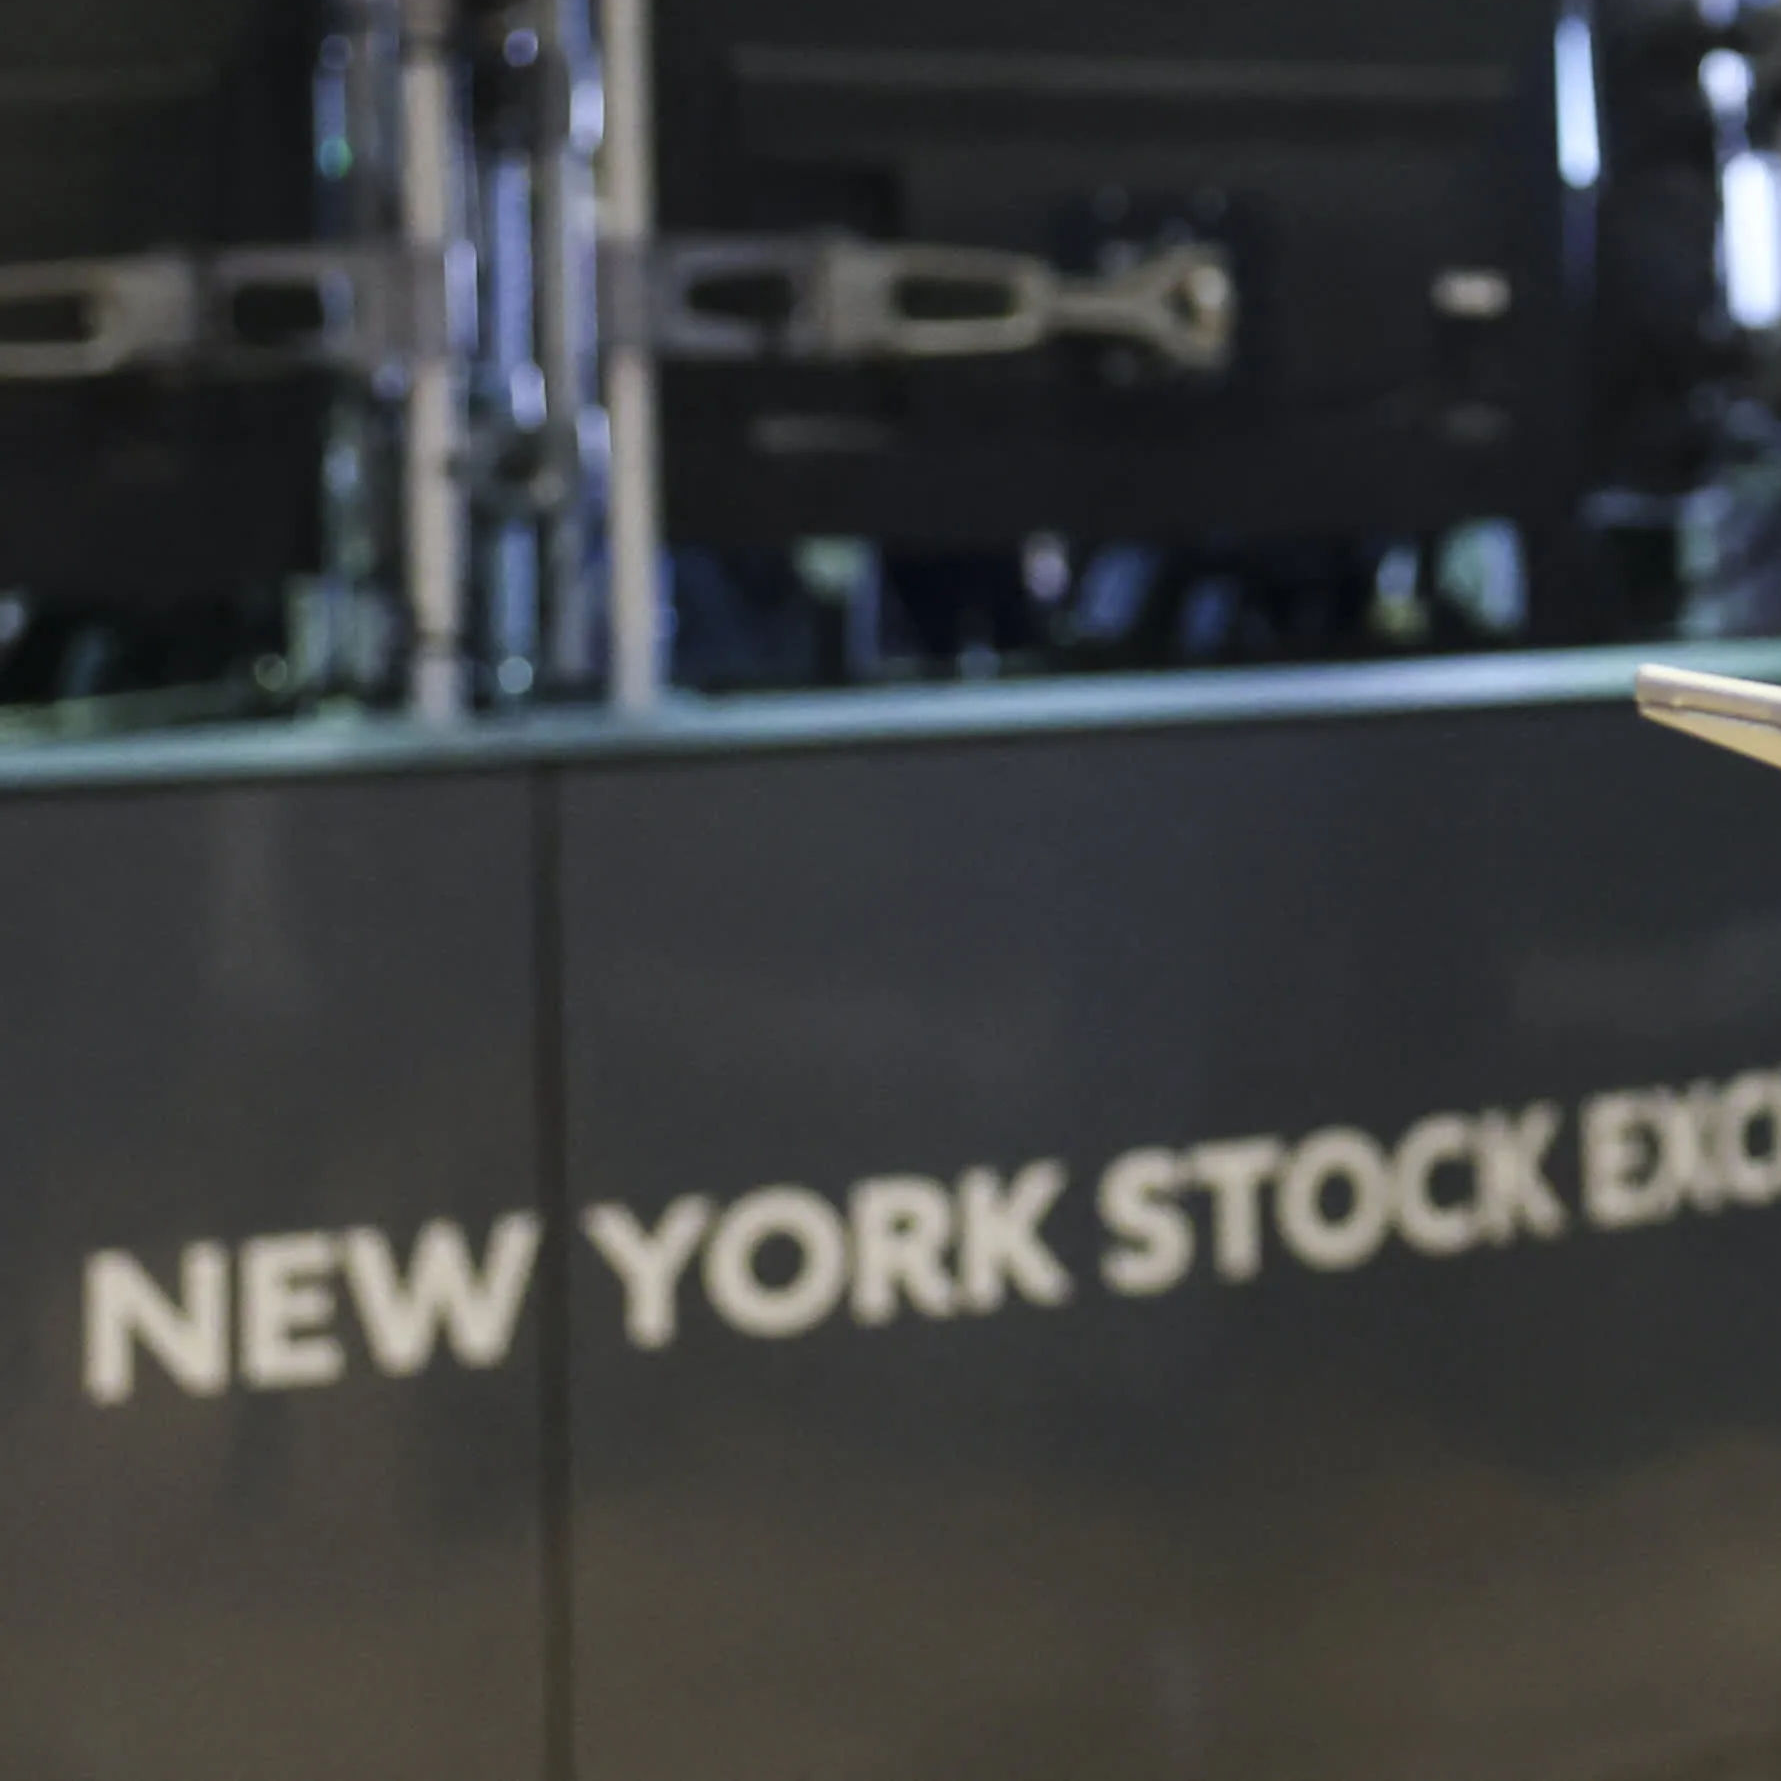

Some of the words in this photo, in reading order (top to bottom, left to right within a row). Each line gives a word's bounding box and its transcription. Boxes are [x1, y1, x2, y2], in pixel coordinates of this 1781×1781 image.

[82, 1211, 541, 1406] NEW
[582, 1164, 1073, 1349] YORK
[1096, 1098, 1565, 1297] STOCK
